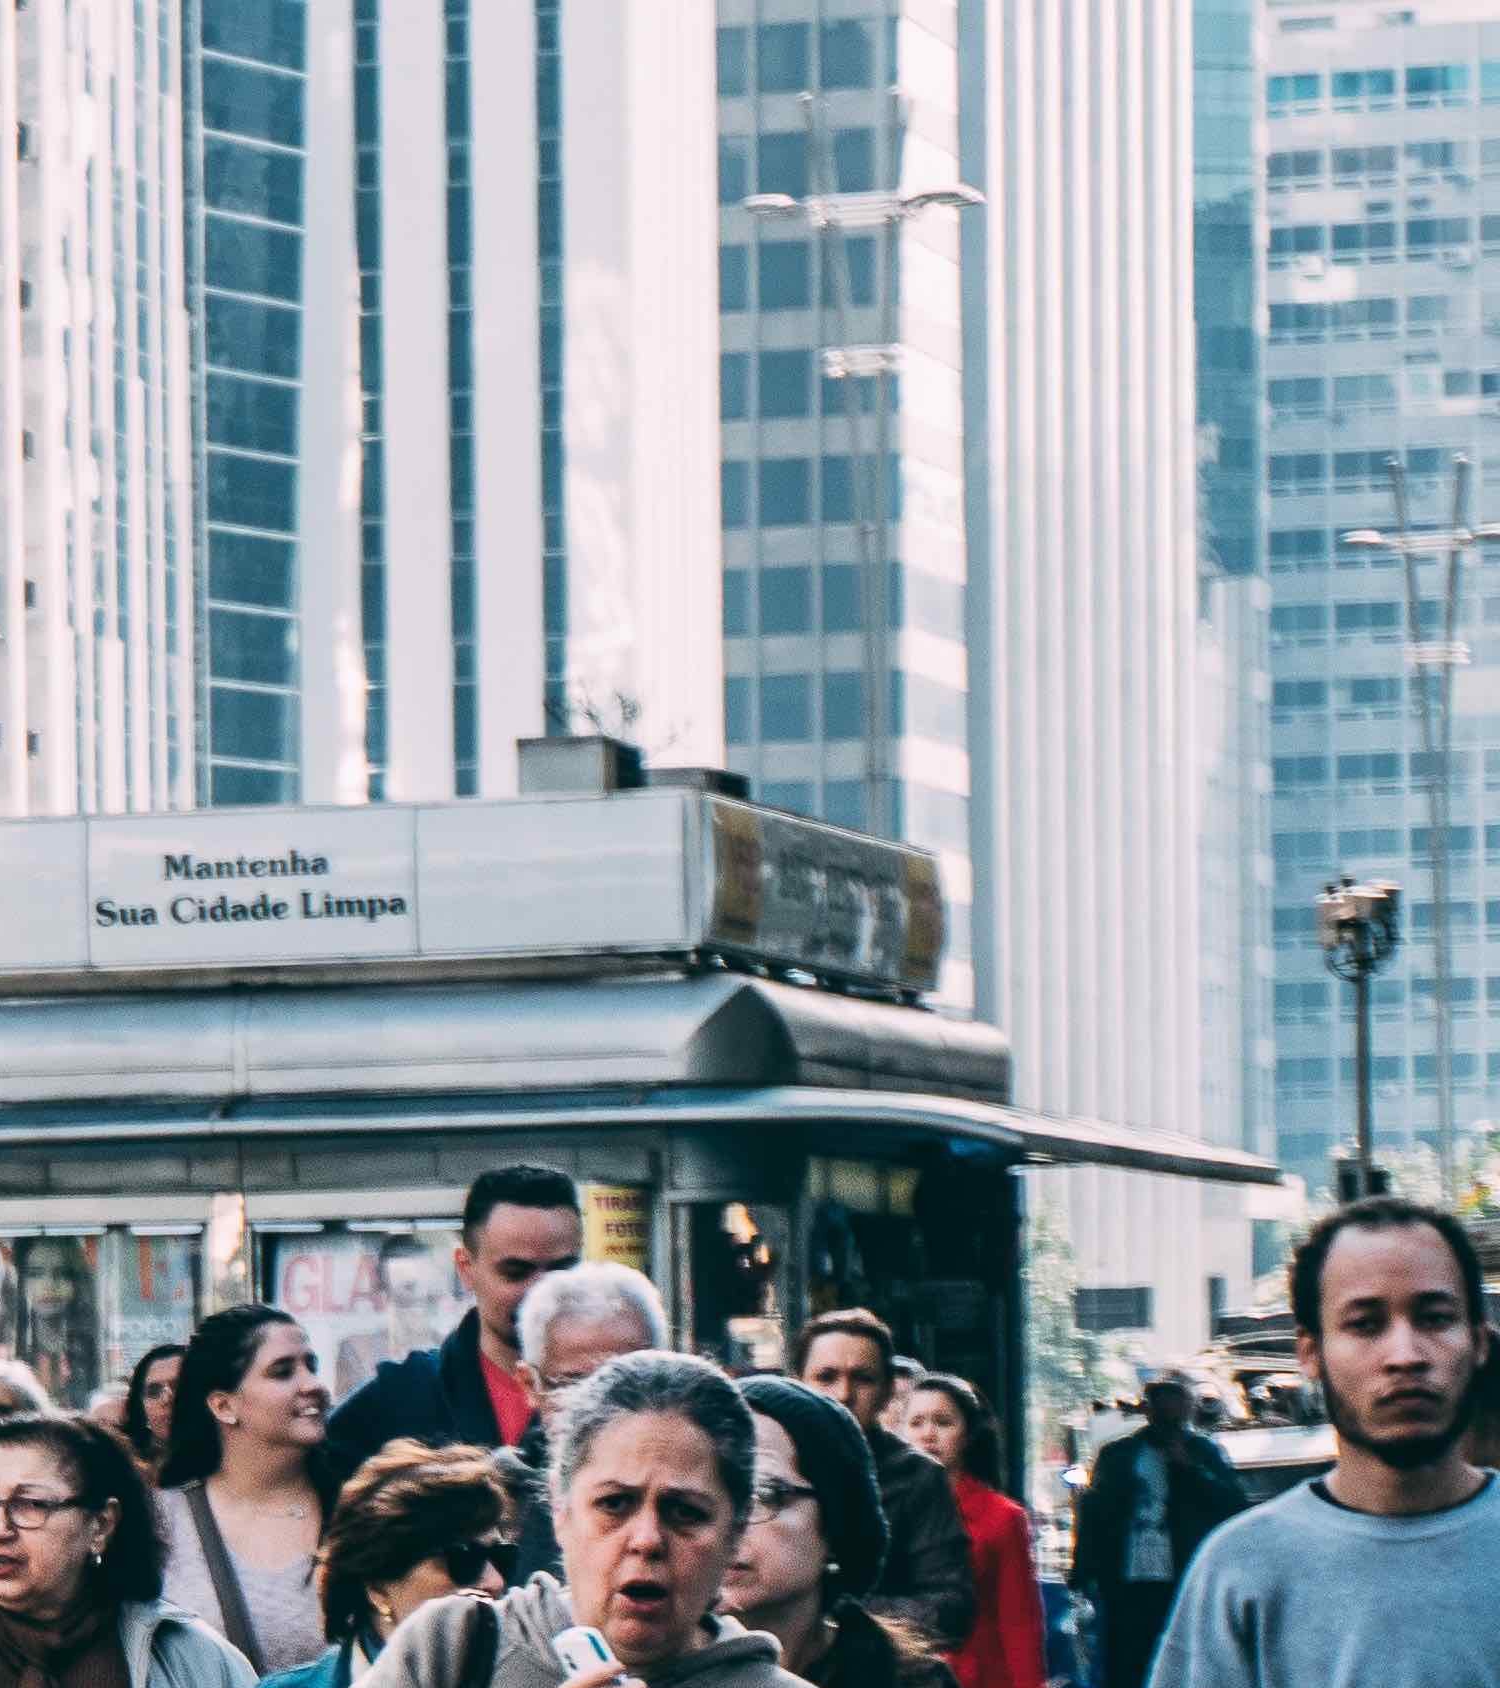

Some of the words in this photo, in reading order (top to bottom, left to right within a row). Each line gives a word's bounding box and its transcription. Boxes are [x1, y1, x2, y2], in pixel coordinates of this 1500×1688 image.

[163, 849, 331, 881] Mantenha
[95, 898, 160, 928] Sua
[170, 893, 290, 924] Cidade
[300, 891, 408, 923] Limpa
